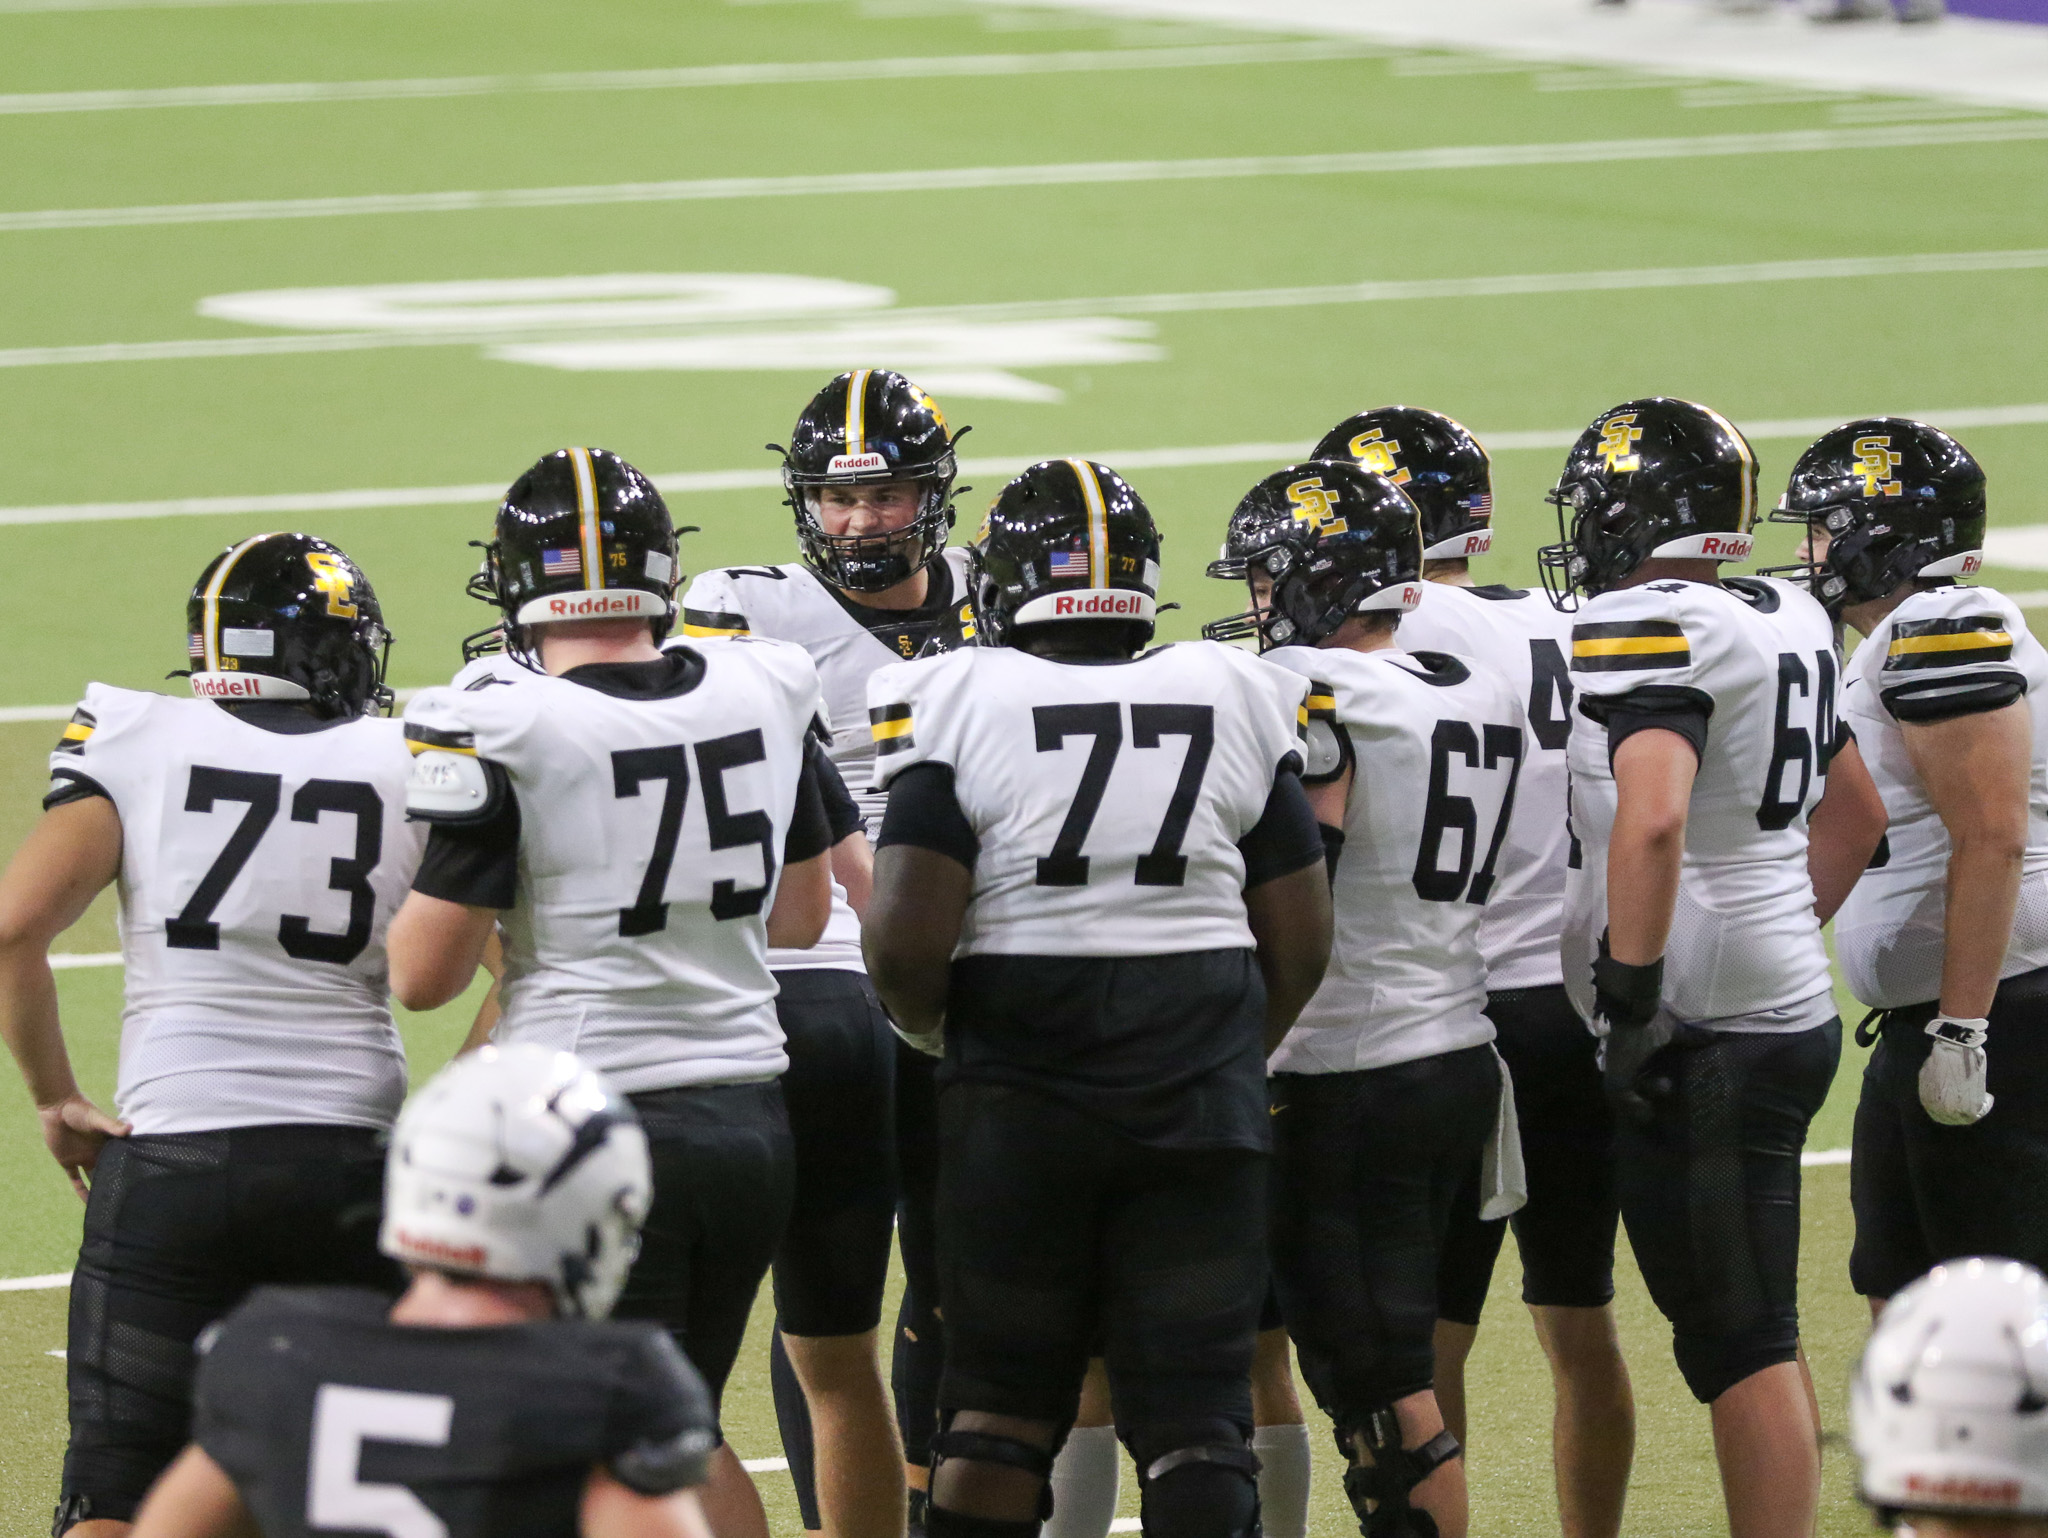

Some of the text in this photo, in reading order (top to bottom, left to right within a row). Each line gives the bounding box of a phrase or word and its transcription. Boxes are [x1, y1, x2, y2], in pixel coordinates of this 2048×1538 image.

[834, 456, 879, 469] Riddell
[609, 552, 627, 567] 75
[1121, 557, 1136, 572] 77
[550, 595, 640, 615] Riddell
[1056, 595, 1142, 615] Riddell
[221, 657, 239, 670] 73
[193, 678, 261, 696] Riddell
[1755, 649, 1839, 831] 64
[1032, 702, 1215, 887] 77
[1412, 720, 1525, 906] 67
[610, 728, 773, 937] 75
[165, 765, 384, 965] 73
[306, 1382, 455, 1538] 5
